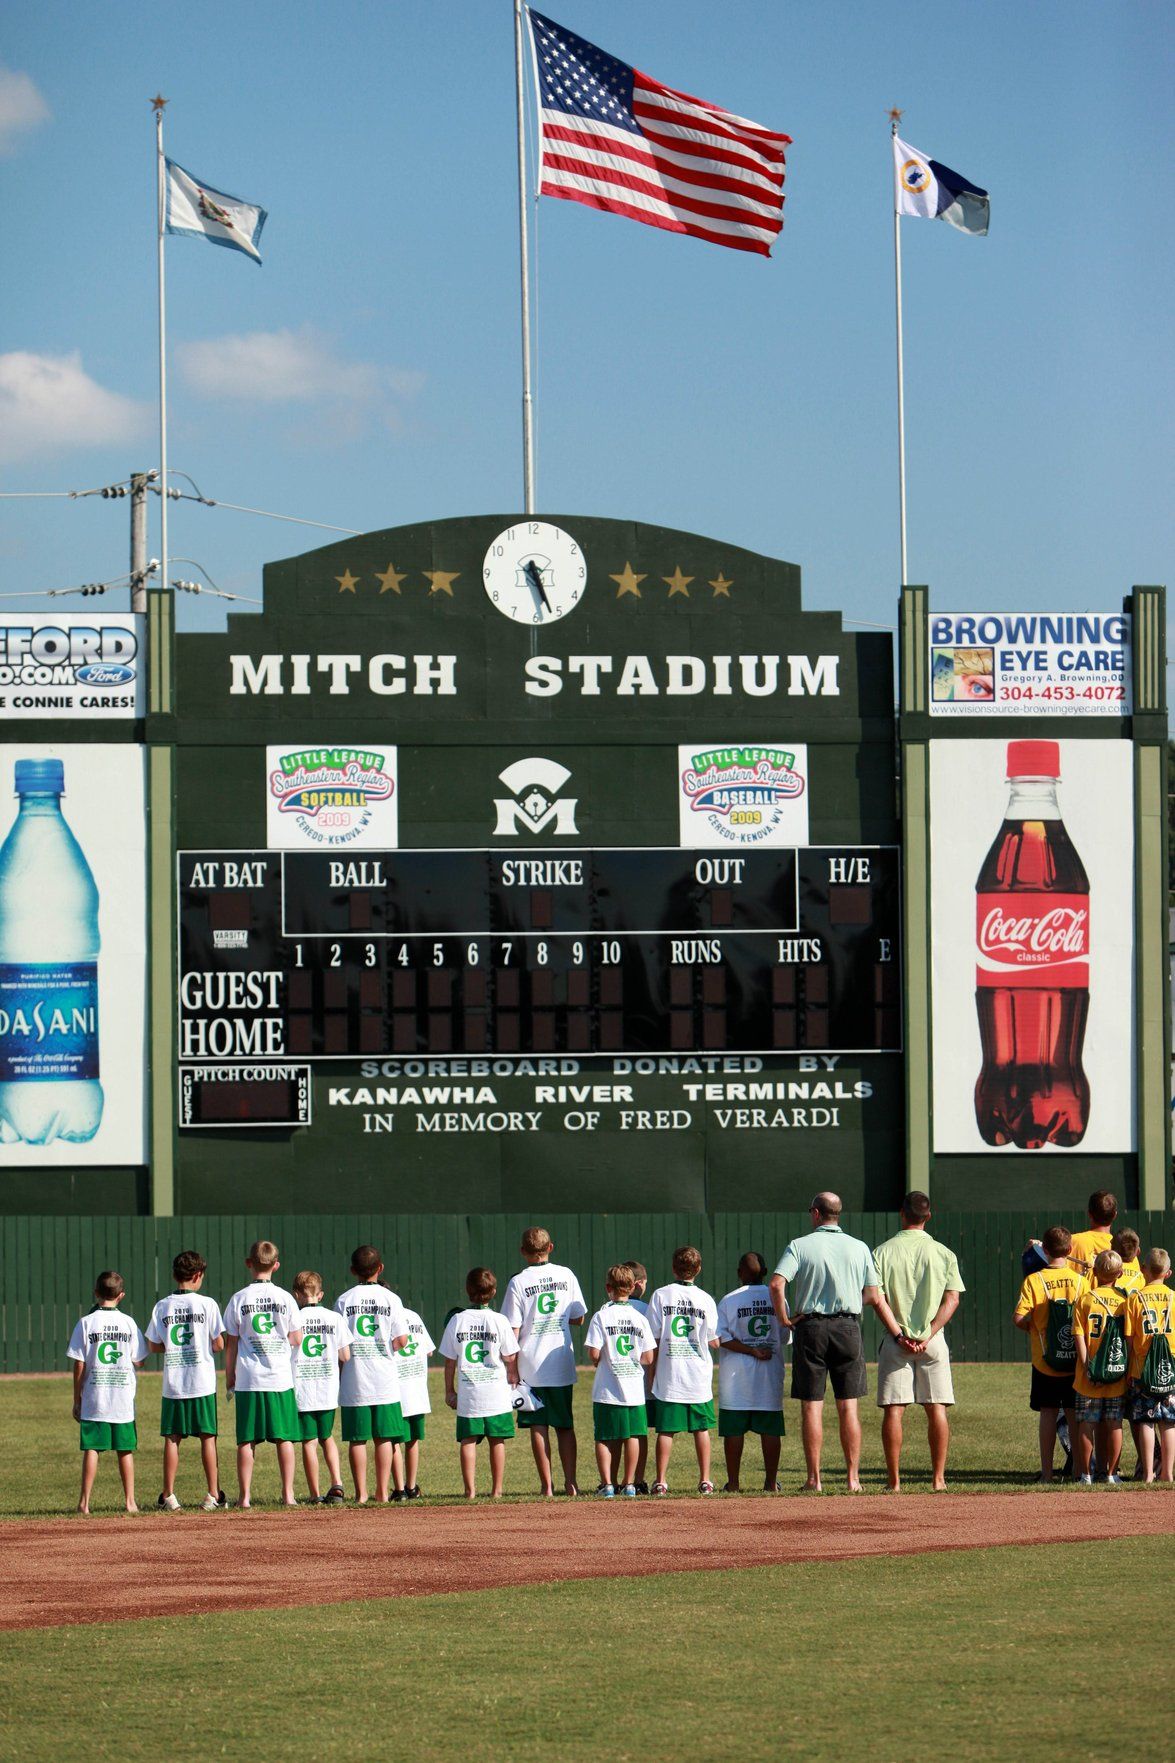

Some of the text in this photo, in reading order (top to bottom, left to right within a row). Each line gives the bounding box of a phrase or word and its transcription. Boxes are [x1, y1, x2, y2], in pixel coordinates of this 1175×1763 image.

[507, 529, 515, 541] 11
[528, 523, 539, 535] 12
[555, 529, 559, 540] 1
[492, 545, 504, 557] 10
[570, 543, 577, 555] 2
[483, 568, 490, 579] 9
[578, 567, 585, 578] 3
[492, 590, 499, 602] 8
[571, 590, 578, 600] 4
[511, 606, 517, 617] 7
[532, 612, 540, 623] 6
[556, 606, 563, 617] 5
[932, 616, 1128, 645] BROWNING
[0, 626, 138, 666] FORD
[1000, 650, 1125, 671] EYE CARE
[86, 665, 123, 682] Ford
[230, 654, 840, 697] MITCH STADIUM
[1001, 674, 1042, 683] Gregory
[1046, 674, 1056, 682] A.
[1000, 686, 1126, 700] 304-453-4072
[13, 696, 73, 708] CONNIE
[80, 696, 135, 708] CARES!
[931, 704, 1129, 715] www.visionsource-browningeyecare.com
[282, 750, 383, 769] LITTLE LEAGUE
[694, 749, 793, 769] LITTLE LEAGUE
[275, 764, 386, 793] Southeastern Region
[686, 763, 795, 791] Southeastern Region
[301, 792, 367, 806] SOFTBALL
[712, 790, 778, 805] BASEBALL
[317, 812, 350, 826] 2009
[359, 810, 373, 826] WV
[730, 811, 761, 825] 2009
[770, 807, 784, 824] WV
[189, 862, 267, 888] AT BAT
[329, 861, 388, 887] BALL
[501, 860, 584, 886] STRIKE
[695, 858, 745, 884] OUT
[828, 857, 871, 883] H/E
[981, 907, 1087, 952] Coca-Cola
[295, 944, 304, 967] 1
[330, 944, 341, 967] 2
[365, 943, 376, 966] 3
[398, 943, 409, 966] 4
[433, 943, 444, 966] 5
[467, 942, 479, 965] 6
[501, 942, 513, 965] 7
[537, 942, 548, 965] 8
[572, 941, 584, 965] 9
[601, 940, 621, 964] 10
[671, 939, 722, 964] RUNS
[778, 938, 821, 963] HITS
[1016, 952, 1051, 961] classic
[181, 971, 283, 1010] GUEST
[182, 1018, 285, 1056] HOME
[193, 1067, 299, 1081] PITCH COUNT
[361, 1055, 841, 1078] SCOREBOARD DONATED BY
[183, 1075, 192, 1125] GUEST
[298, 1077, 307, 1121] HOME
[328, 1081, 873, 1105] KANAWHA RIVER TERMINALS
[363, 1107, 840, 1132] IN MEMORY OF FRED VERARDI
[1046, 1279, 1074, 1290] BEATTY
[1142, 1309, 1172, 1334] 21
[1056, 1350, 1077, 1359] BEATT
